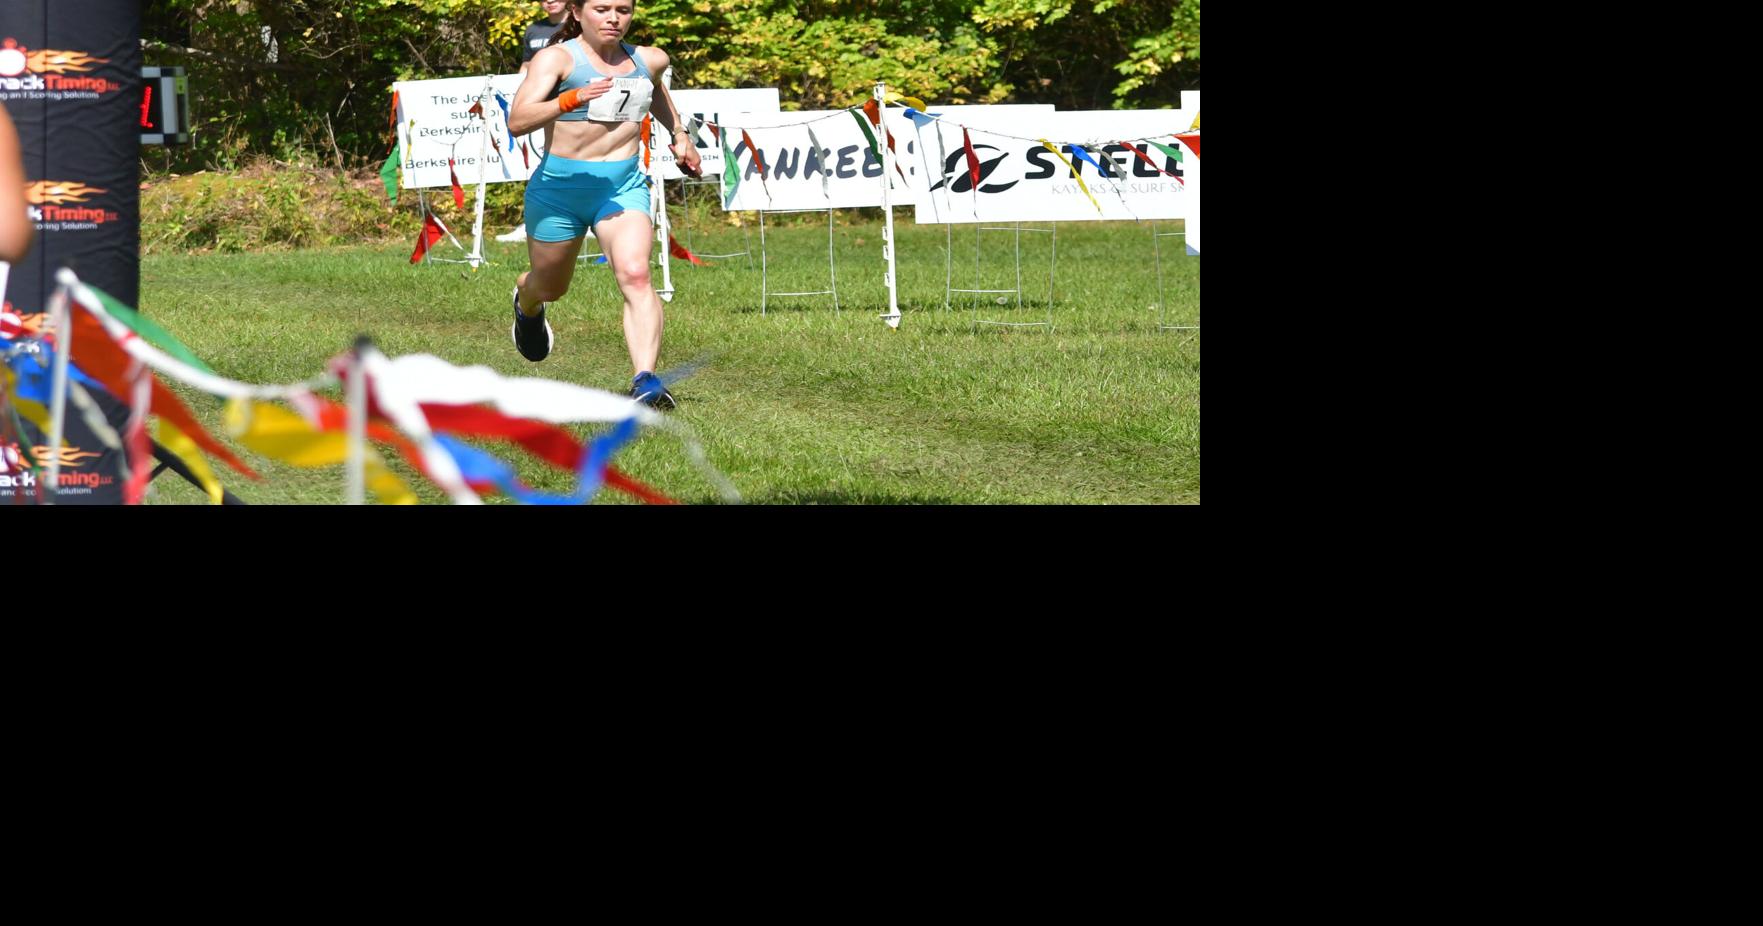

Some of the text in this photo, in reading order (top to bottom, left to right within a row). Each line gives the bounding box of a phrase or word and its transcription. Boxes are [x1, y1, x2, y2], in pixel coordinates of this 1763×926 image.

[29, 91, 61, 100] Scoing
[64, 91, 100, 99] Solutions
[431, 95, 458, 106] The
[619, 89, 631, 113] 7
[420, 124, 481, 138] Berkshir
[1051, 183, 1107, 196] KAYKS
[1130, 183, 1166, 195] SURF
[61, 222, 98, 230] Solutions
